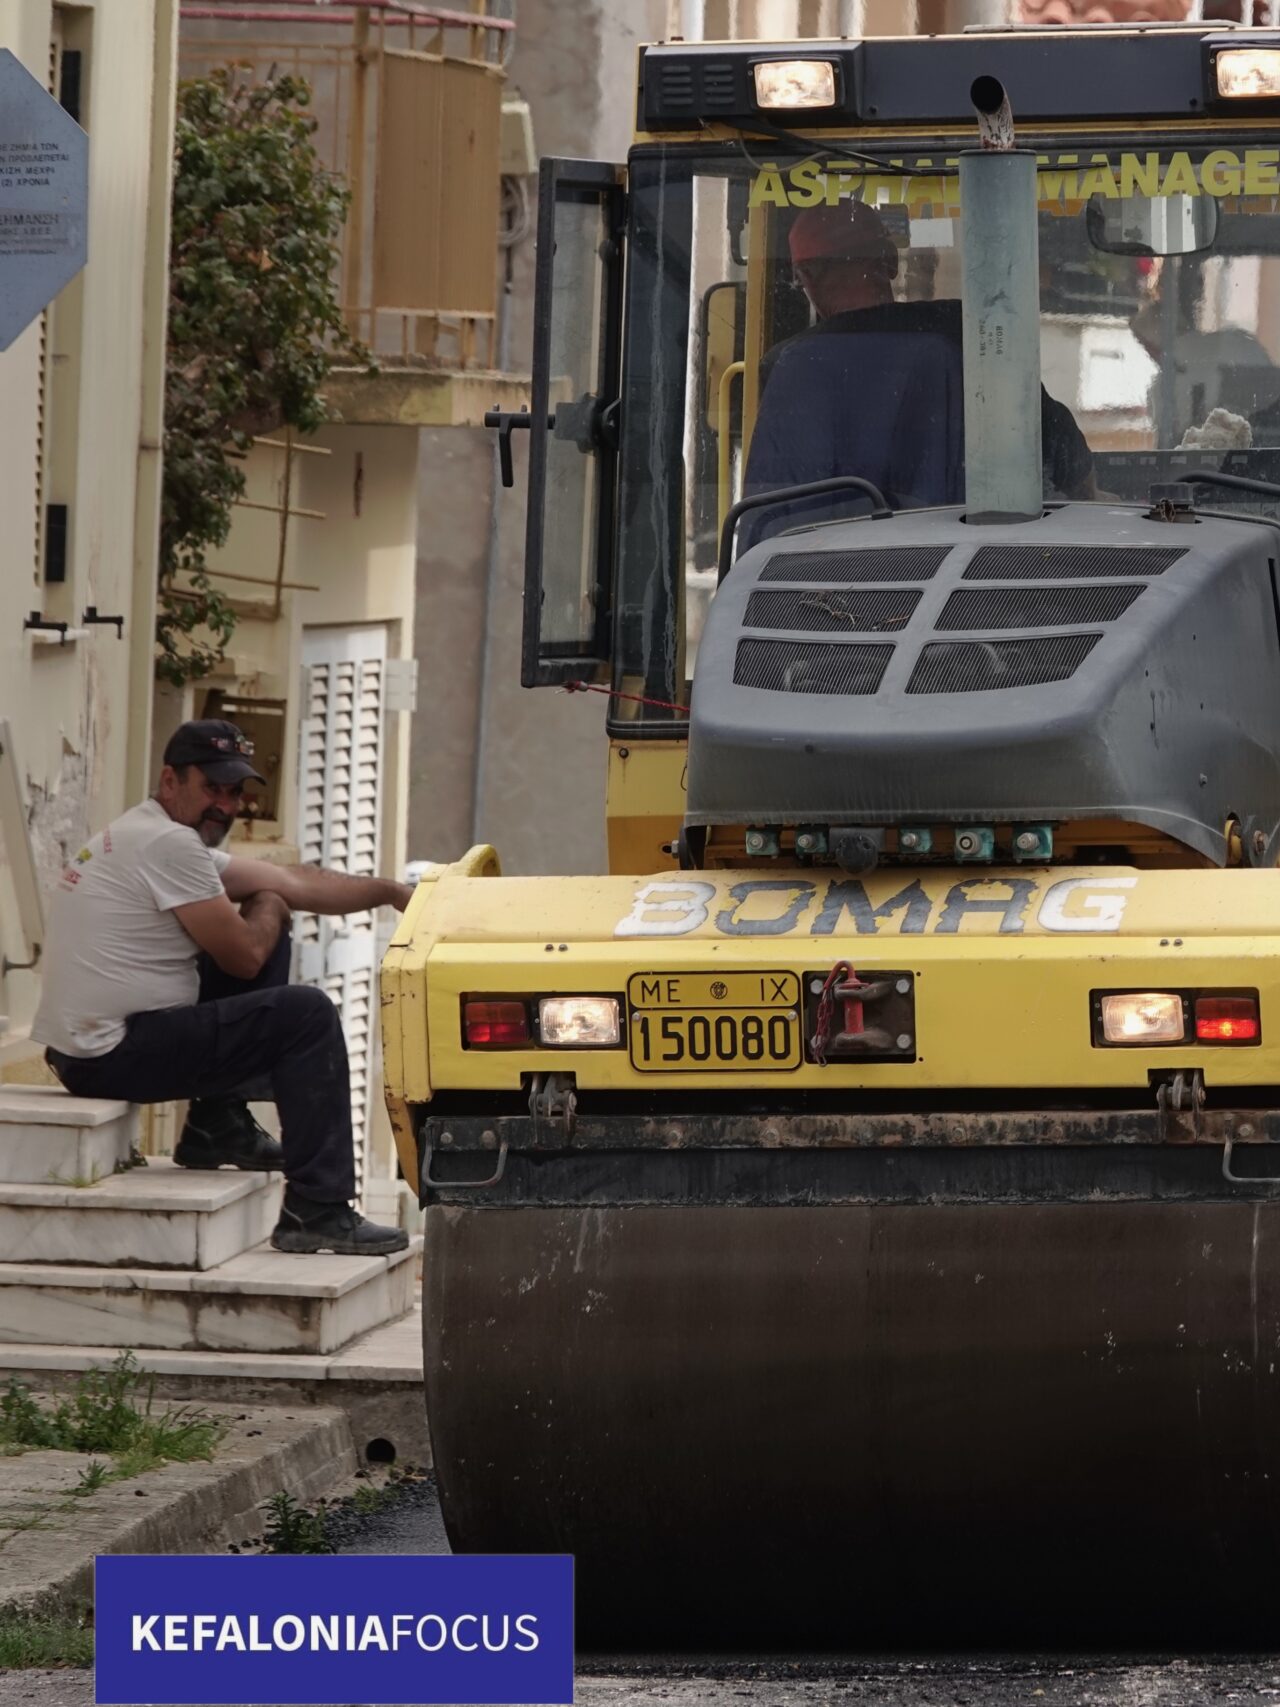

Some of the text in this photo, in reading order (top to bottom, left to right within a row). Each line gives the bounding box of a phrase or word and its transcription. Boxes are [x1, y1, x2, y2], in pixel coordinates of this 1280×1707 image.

[9, 144, 38, 152] ΖΗΜΙΑ
[40, 143, 59, 151] ΤΩΝ
[25, 166, 55, 175] ΜΕΧΡΙ
[1, 178, 50, 188] (2) ΧΡΟΝΙΑ
[614, 877, 1138, 936] BOMAG
[641, 978, 789, 1003] ME IX
[640, 1015, 791, 1062] 150080
